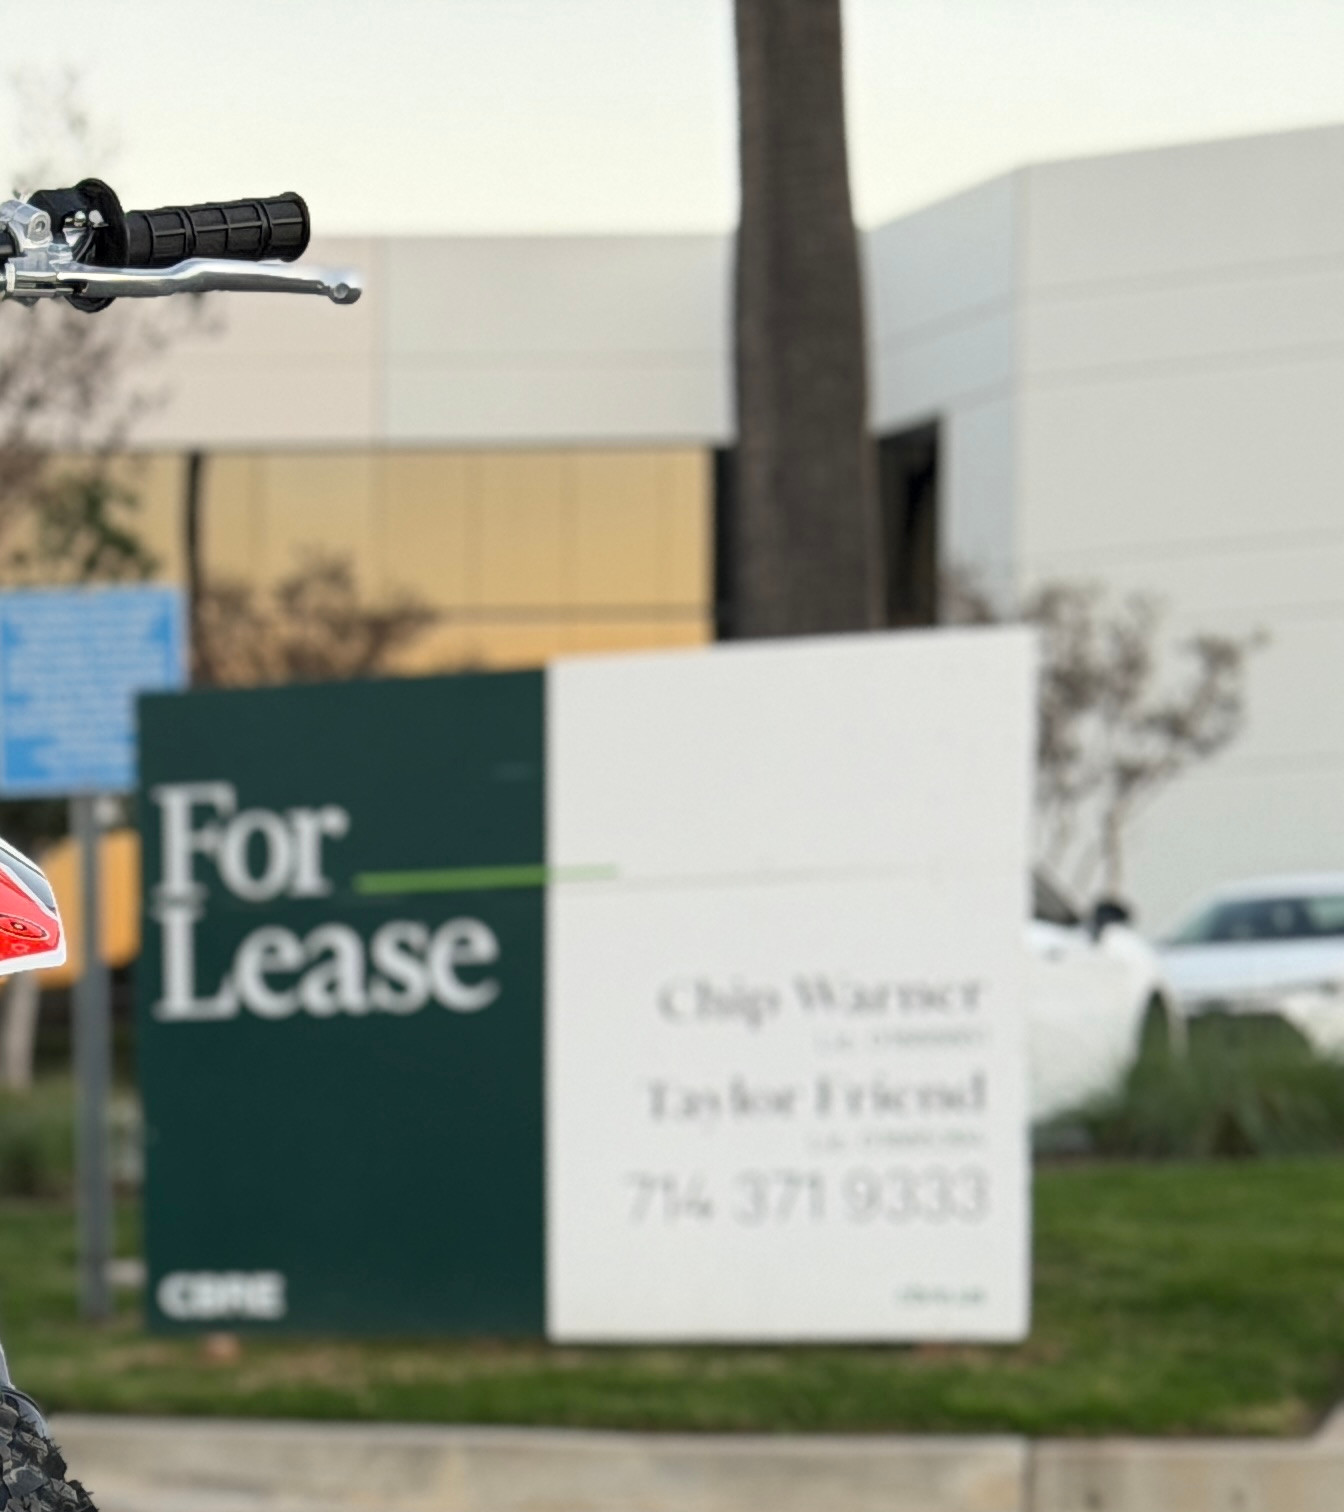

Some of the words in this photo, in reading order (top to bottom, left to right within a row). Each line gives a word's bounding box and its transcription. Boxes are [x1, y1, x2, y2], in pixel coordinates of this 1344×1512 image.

[152, 780, 350, 902] For
[151, 902, 502, 1022] Lease
[657, 973, 782, 1031] Chip
[624, 1170, 714, 1227] 714
[733, 1168, 827, 1228] 371
[841, 1164, 991, 1227] 9333
